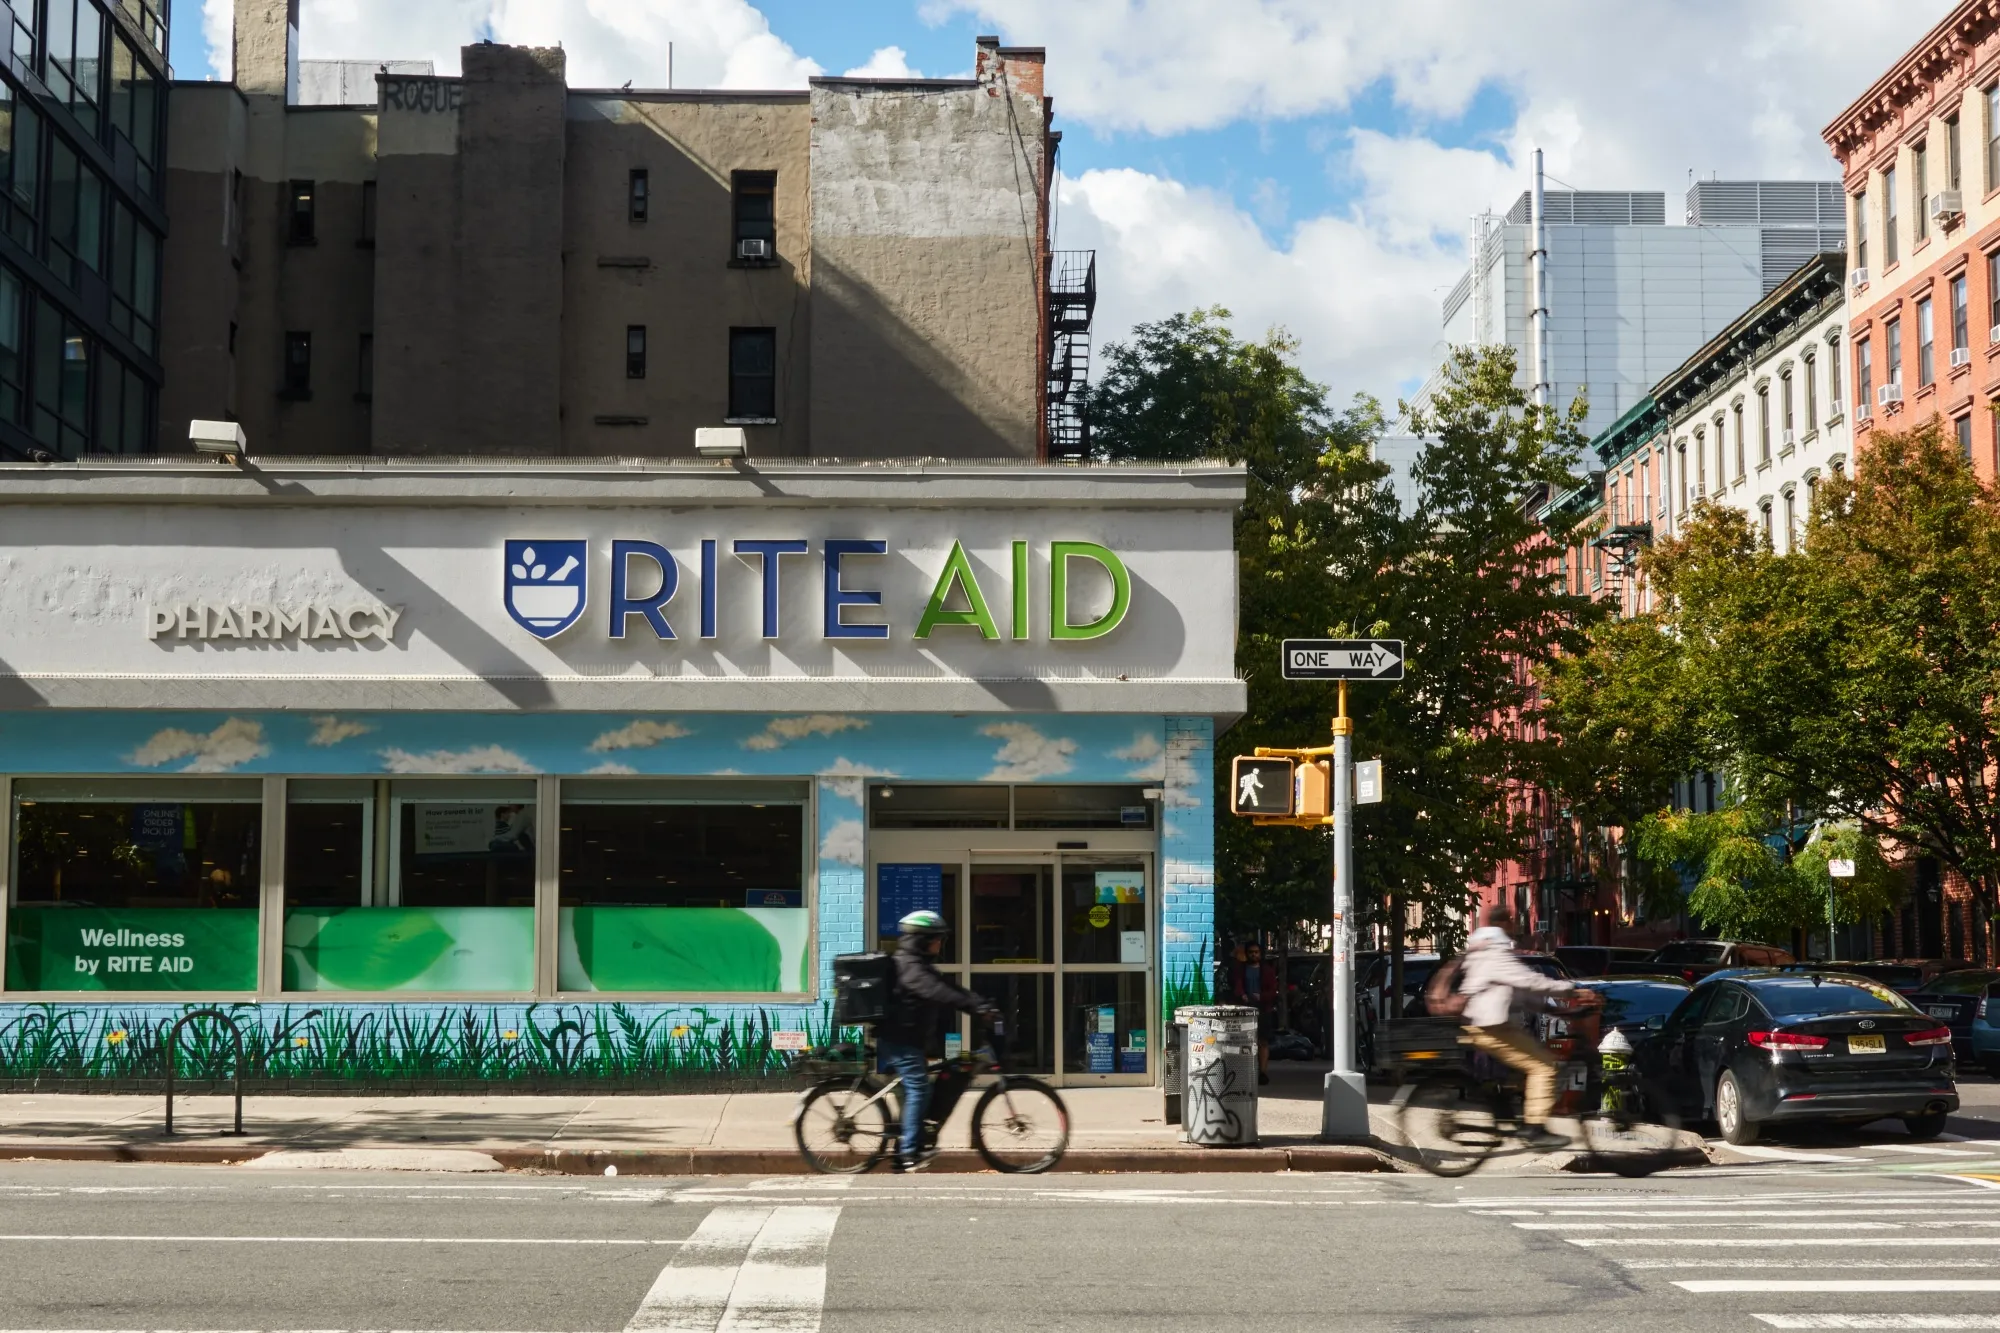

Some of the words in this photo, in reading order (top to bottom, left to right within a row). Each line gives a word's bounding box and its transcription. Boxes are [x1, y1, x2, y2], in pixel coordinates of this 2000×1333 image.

[384, 80, 463, 114] ROGUE
[608, 538, 890, 641] RITE
[912, 537, 1133, 642] AID
[148, 604, 404, 641] PHARMACY
[1294, 652, 1329, 667] ONE
[1349, 652, 1387, 667] WAY
[143, 809, 175, 818] ONLINE
[143, 818, 173, 827] ORDER
[142, 827, 162, 836] PICK
[163, 827, 176, 837] UP
[80, 928, 185, 948] Wellness
[74, 955, 100, 976] by
[107, 956, 152, 973] RITE
[158, 956, 193, 973] AID
